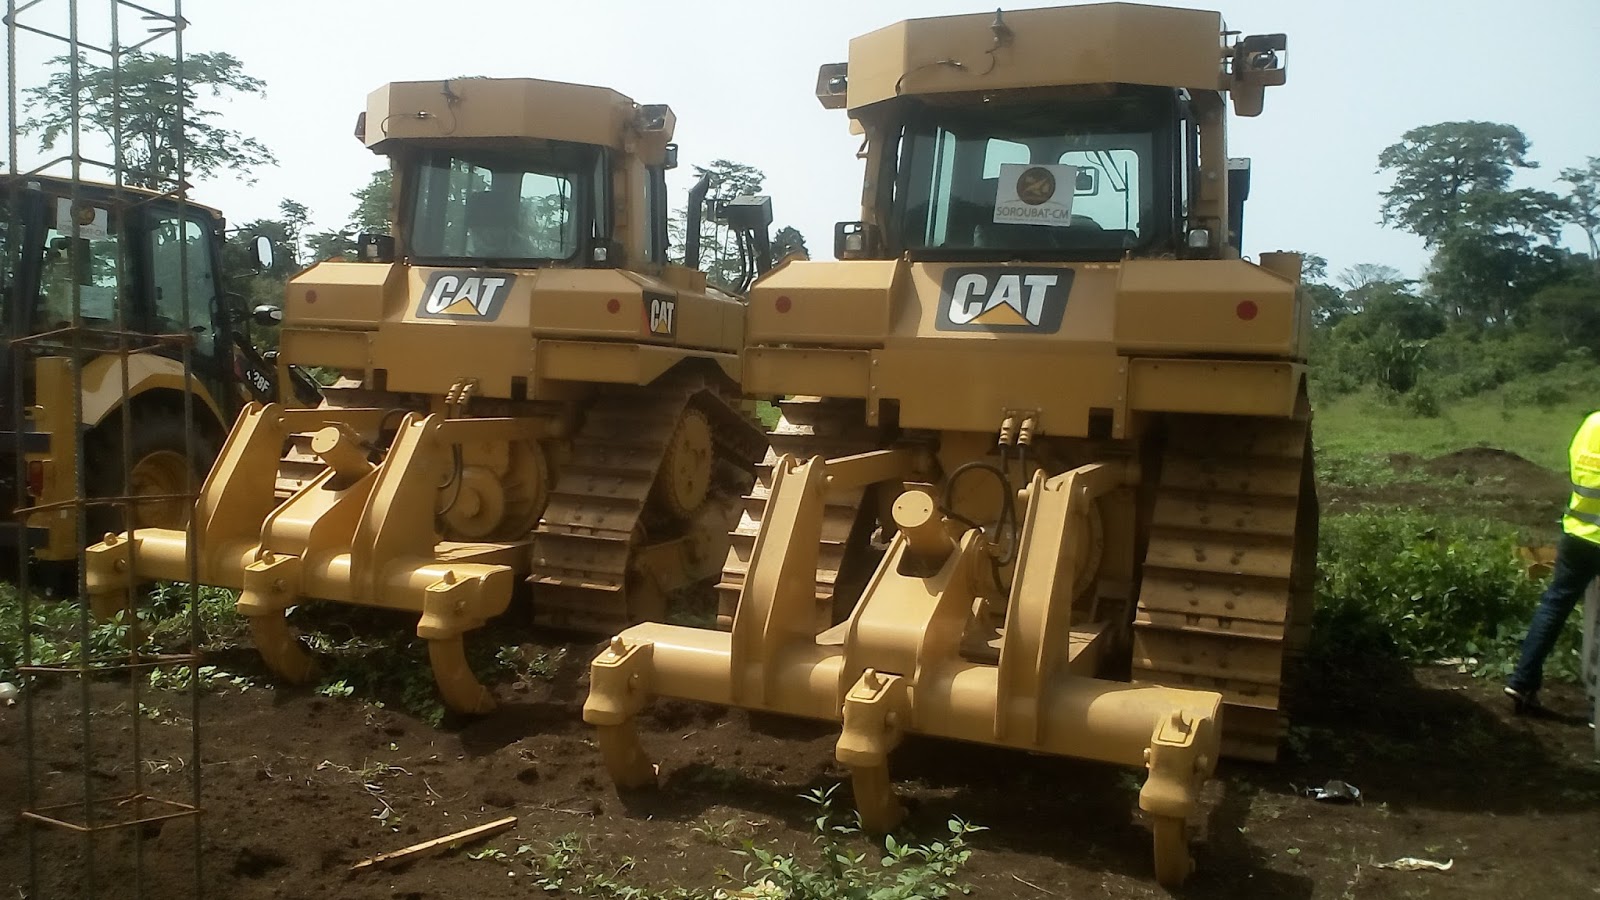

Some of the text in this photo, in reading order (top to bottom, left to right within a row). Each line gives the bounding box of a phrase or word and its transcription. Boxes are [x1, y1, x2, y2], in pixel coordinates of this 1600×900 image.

[996, 206, 1069, 219] SOROUBAT-CM
[426, 276, 506, 315] CAT
[948, 273, 1058, 326] CAT
[650, 299, 675, 334] CAT
